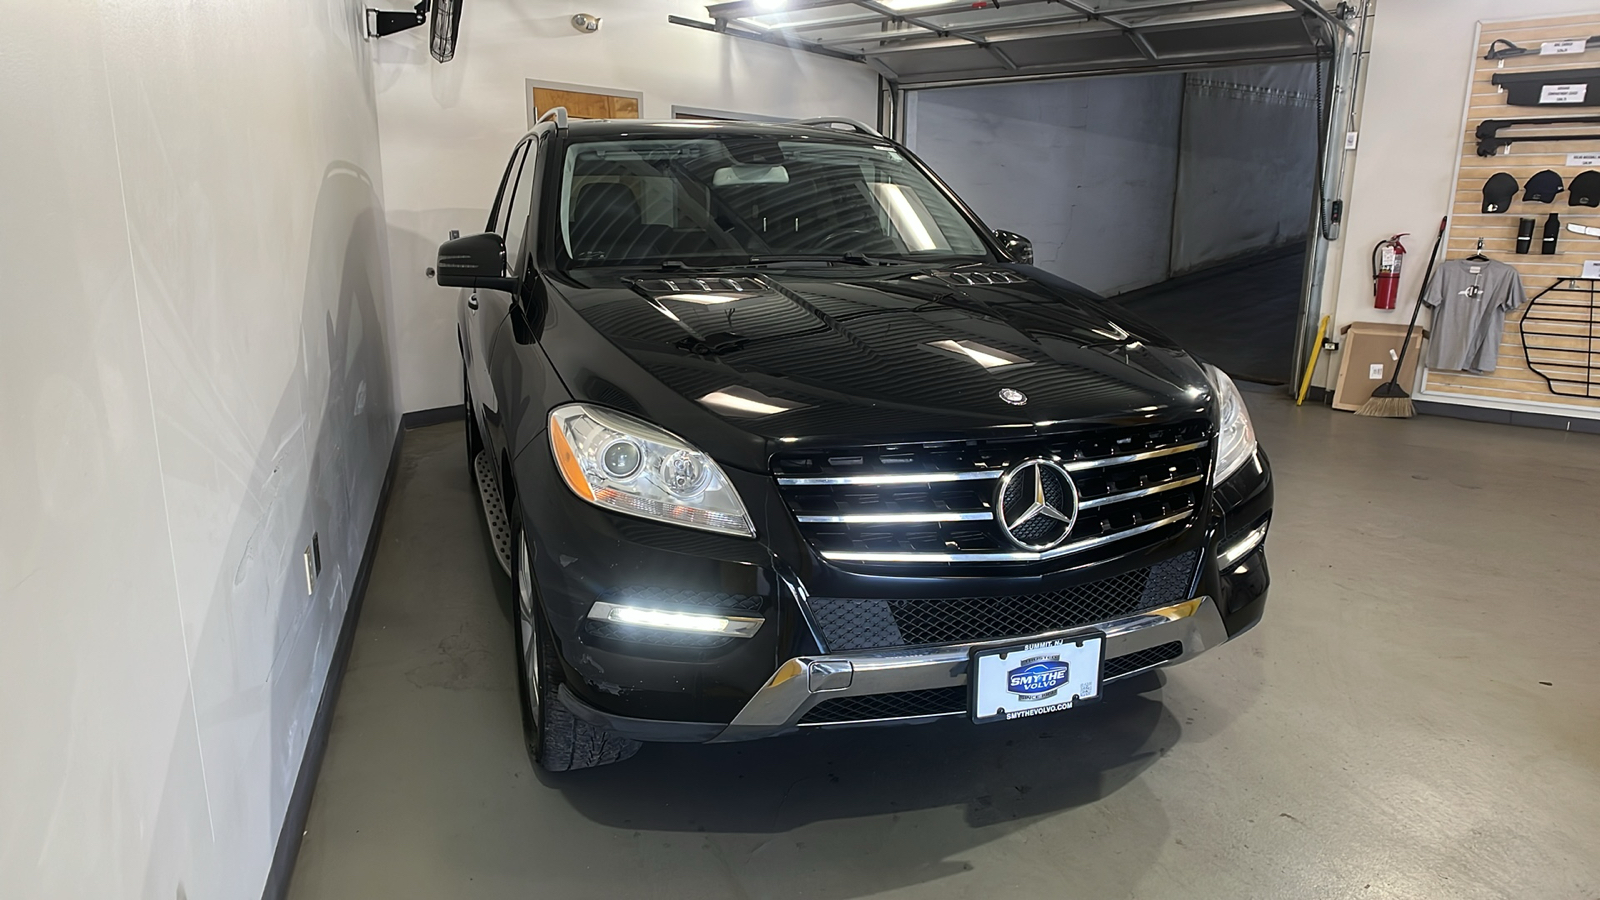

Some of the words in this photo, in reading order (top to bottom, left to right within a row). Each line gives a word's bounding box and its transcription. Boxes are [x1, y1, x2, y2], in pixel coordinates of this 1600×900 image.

[1011, 670, 1065, 686] SMYTHE
[1024, 680, 1057, 690] VOLVO
[1006, 702, 1073, 720] SMYTHEVOLVO.COM
